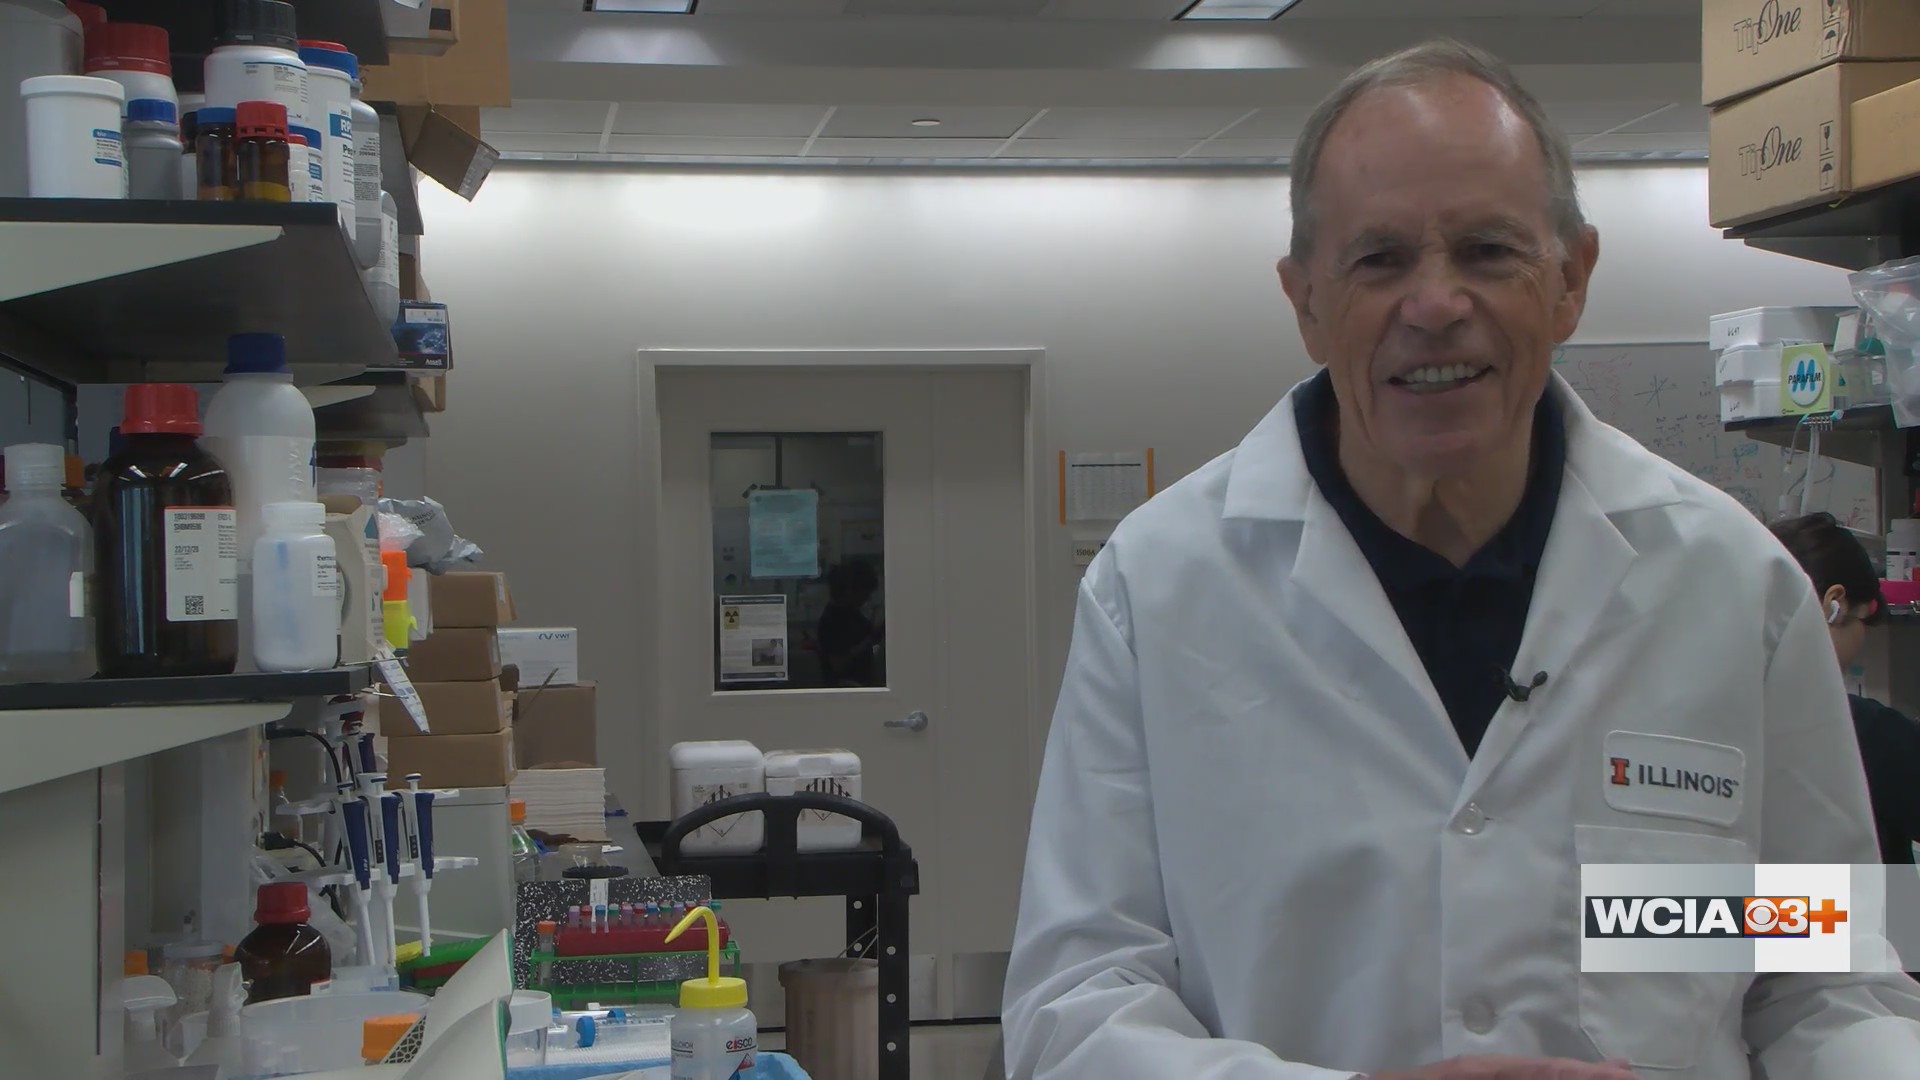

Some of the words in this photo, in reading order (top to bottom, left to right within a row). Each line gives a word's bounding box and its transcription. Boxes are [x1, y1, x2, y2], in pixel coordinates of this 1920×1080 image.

[1738, 126, 1803, 181] TipOne
[1787, 372, 1822, 385] PARAFILM
[1638, 764, 1734, 799] ILLINOIS
[726, 1037, 753, 1050] eisco
